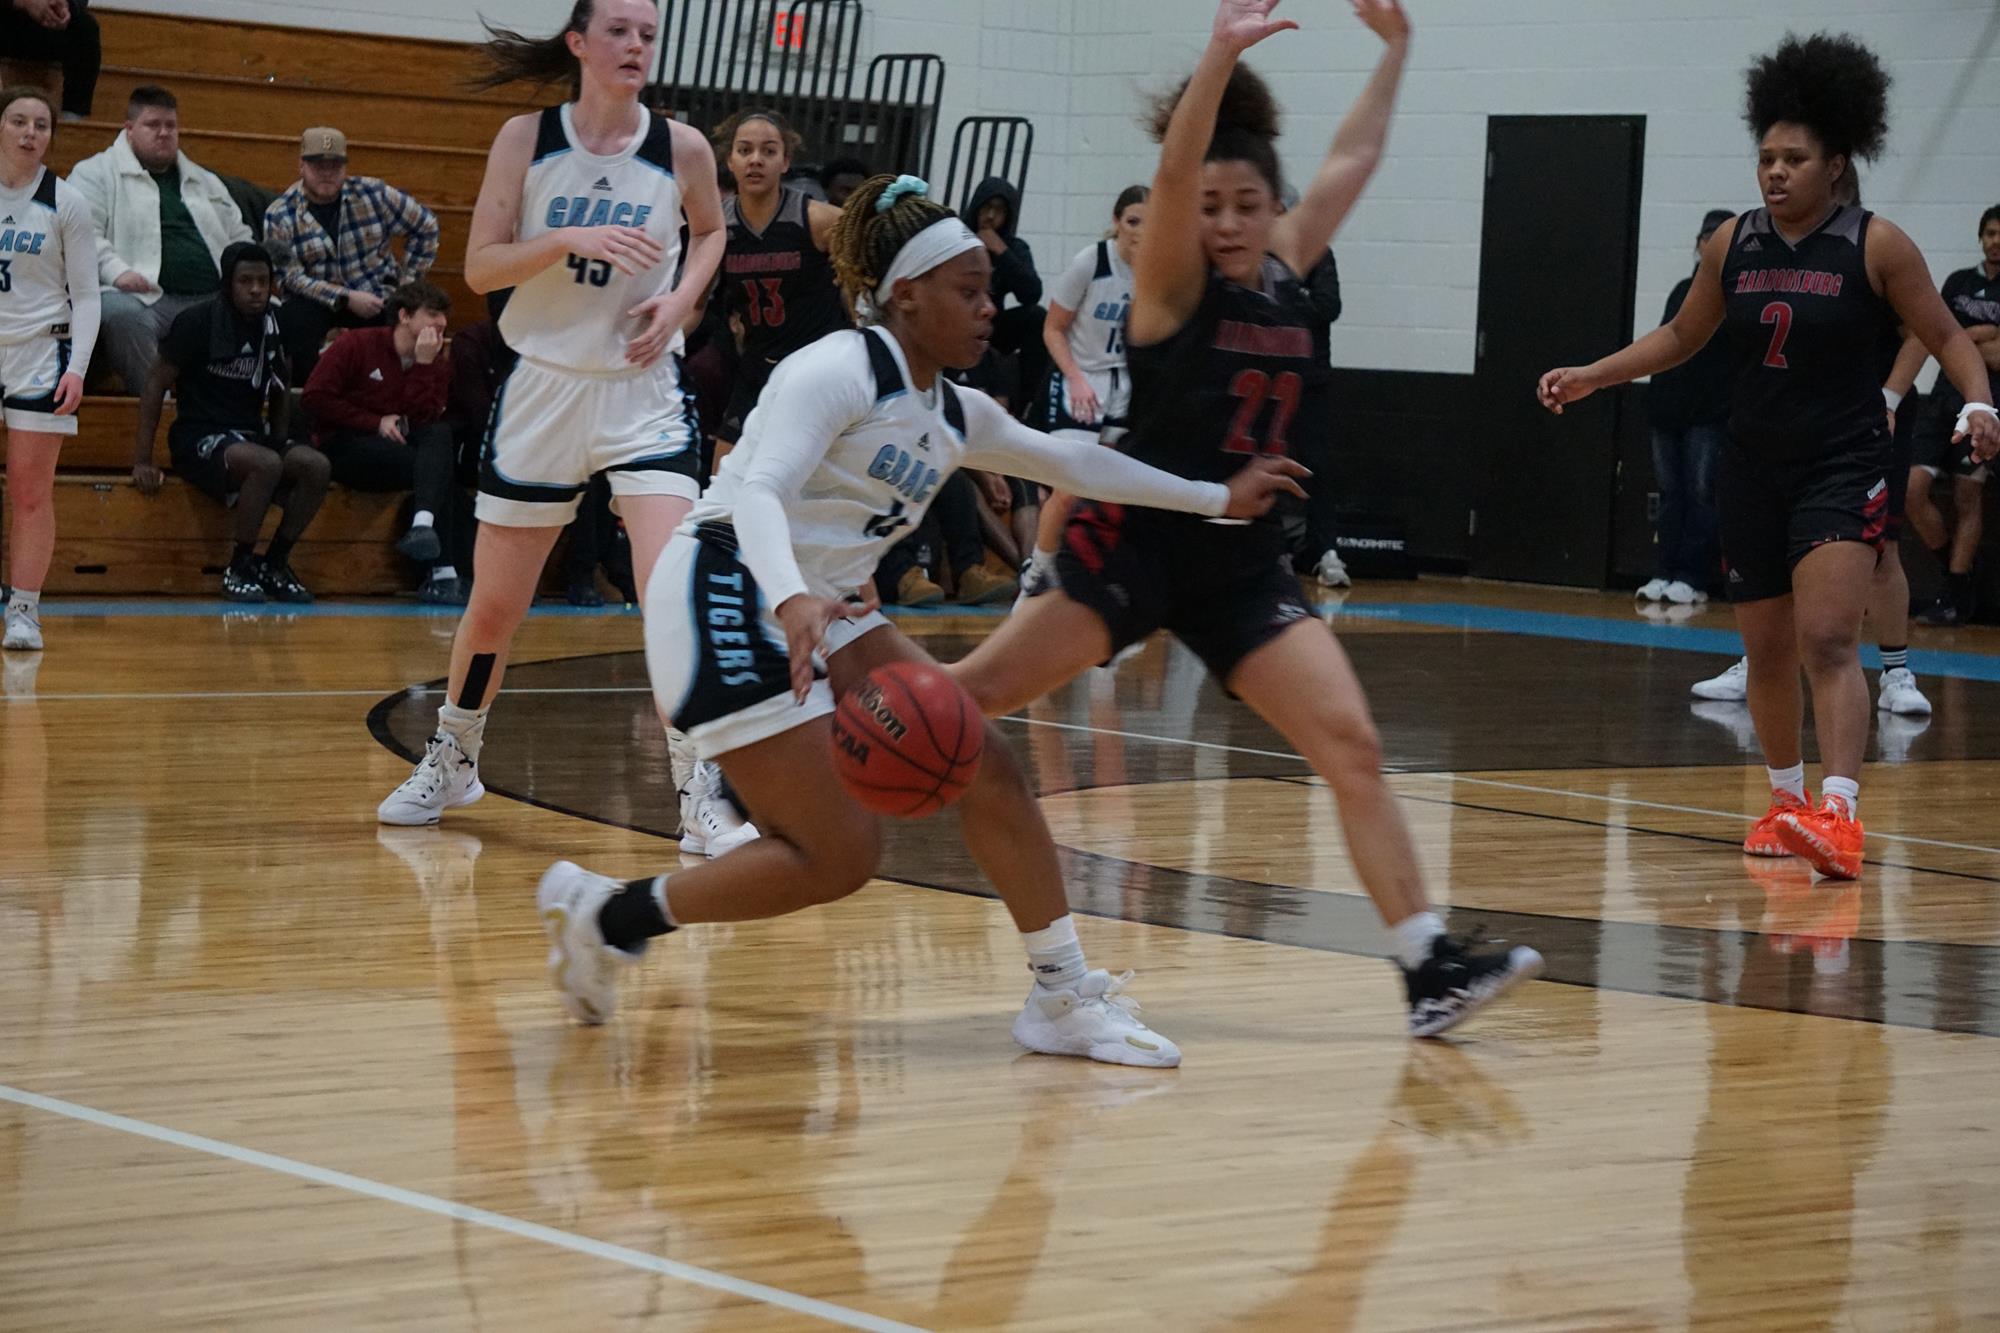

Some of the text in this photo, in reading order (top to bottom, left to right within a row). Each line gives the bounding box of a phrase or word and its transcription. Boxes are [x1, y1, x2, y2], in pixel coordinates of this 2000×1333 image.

[546, 196, 652, 229] GRACE
[0, 229, 46, 255] ACE
[741, 278, 786, 327] 13
[1093, 302, 1131, 321] GRA
[1760, 301, 1793, 369] 2
[867, 443, 939, 503] GRAC
[707, 572, 763, 686] TIGERS
